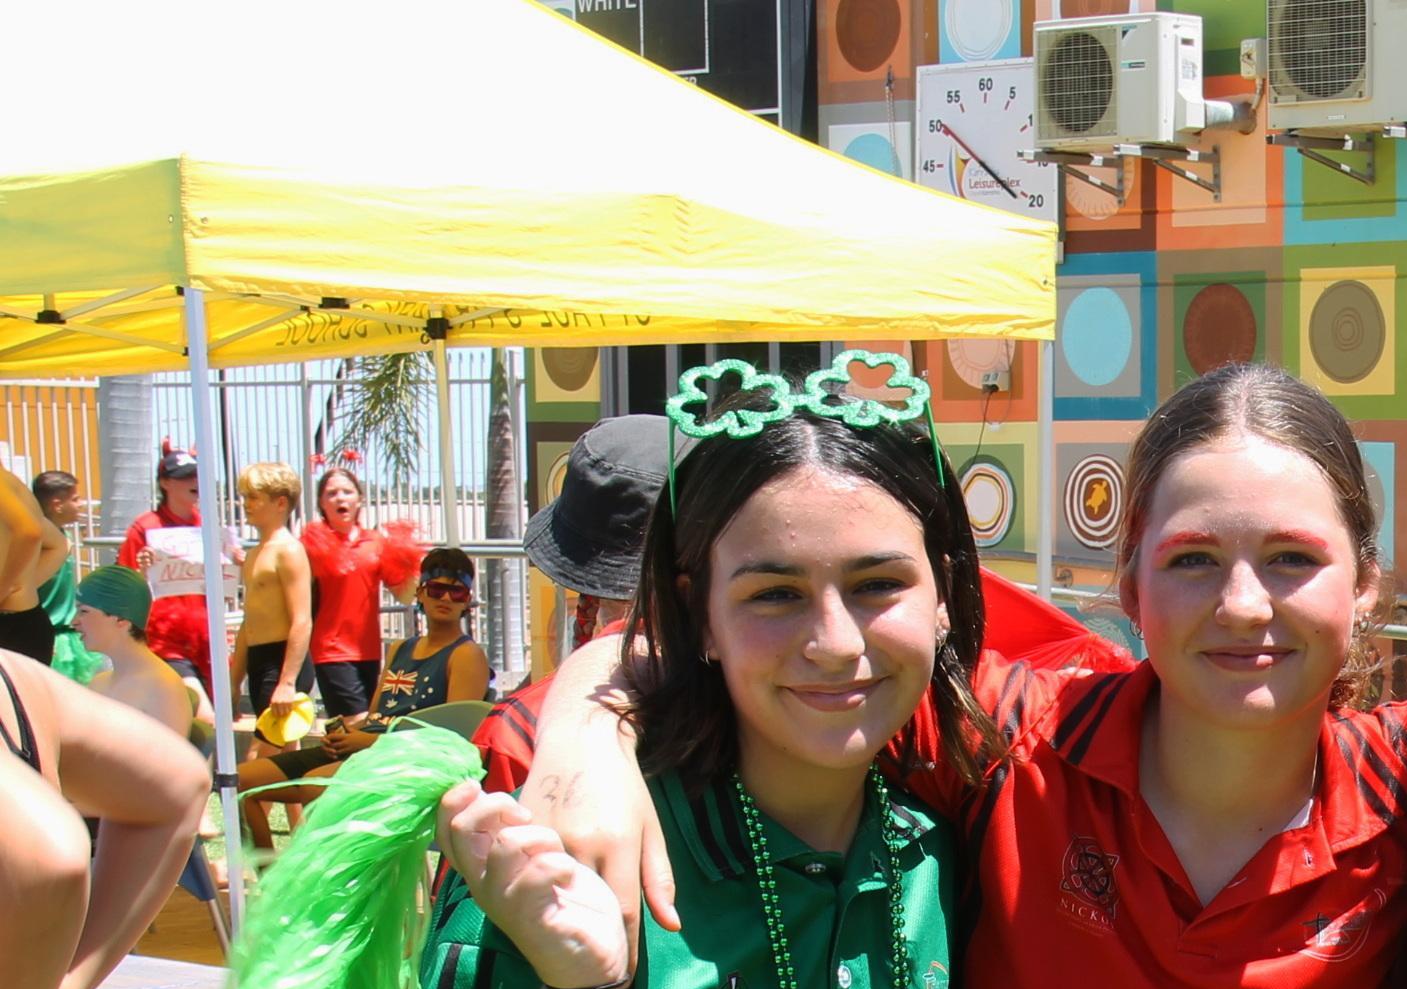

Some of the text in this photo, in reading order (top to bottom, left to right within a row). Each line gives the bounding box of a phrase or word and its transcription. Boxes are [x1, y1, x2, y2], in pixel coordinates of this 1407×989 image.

[978, 78, 993, 91] 60
[946, 90, 961, 104] 55
[1009, 86, 1016, 100] 5
[929, 119, 942, 133] 50
[923, 160, 936, 173] 45
[1028, 194, 1044, 208] 20
